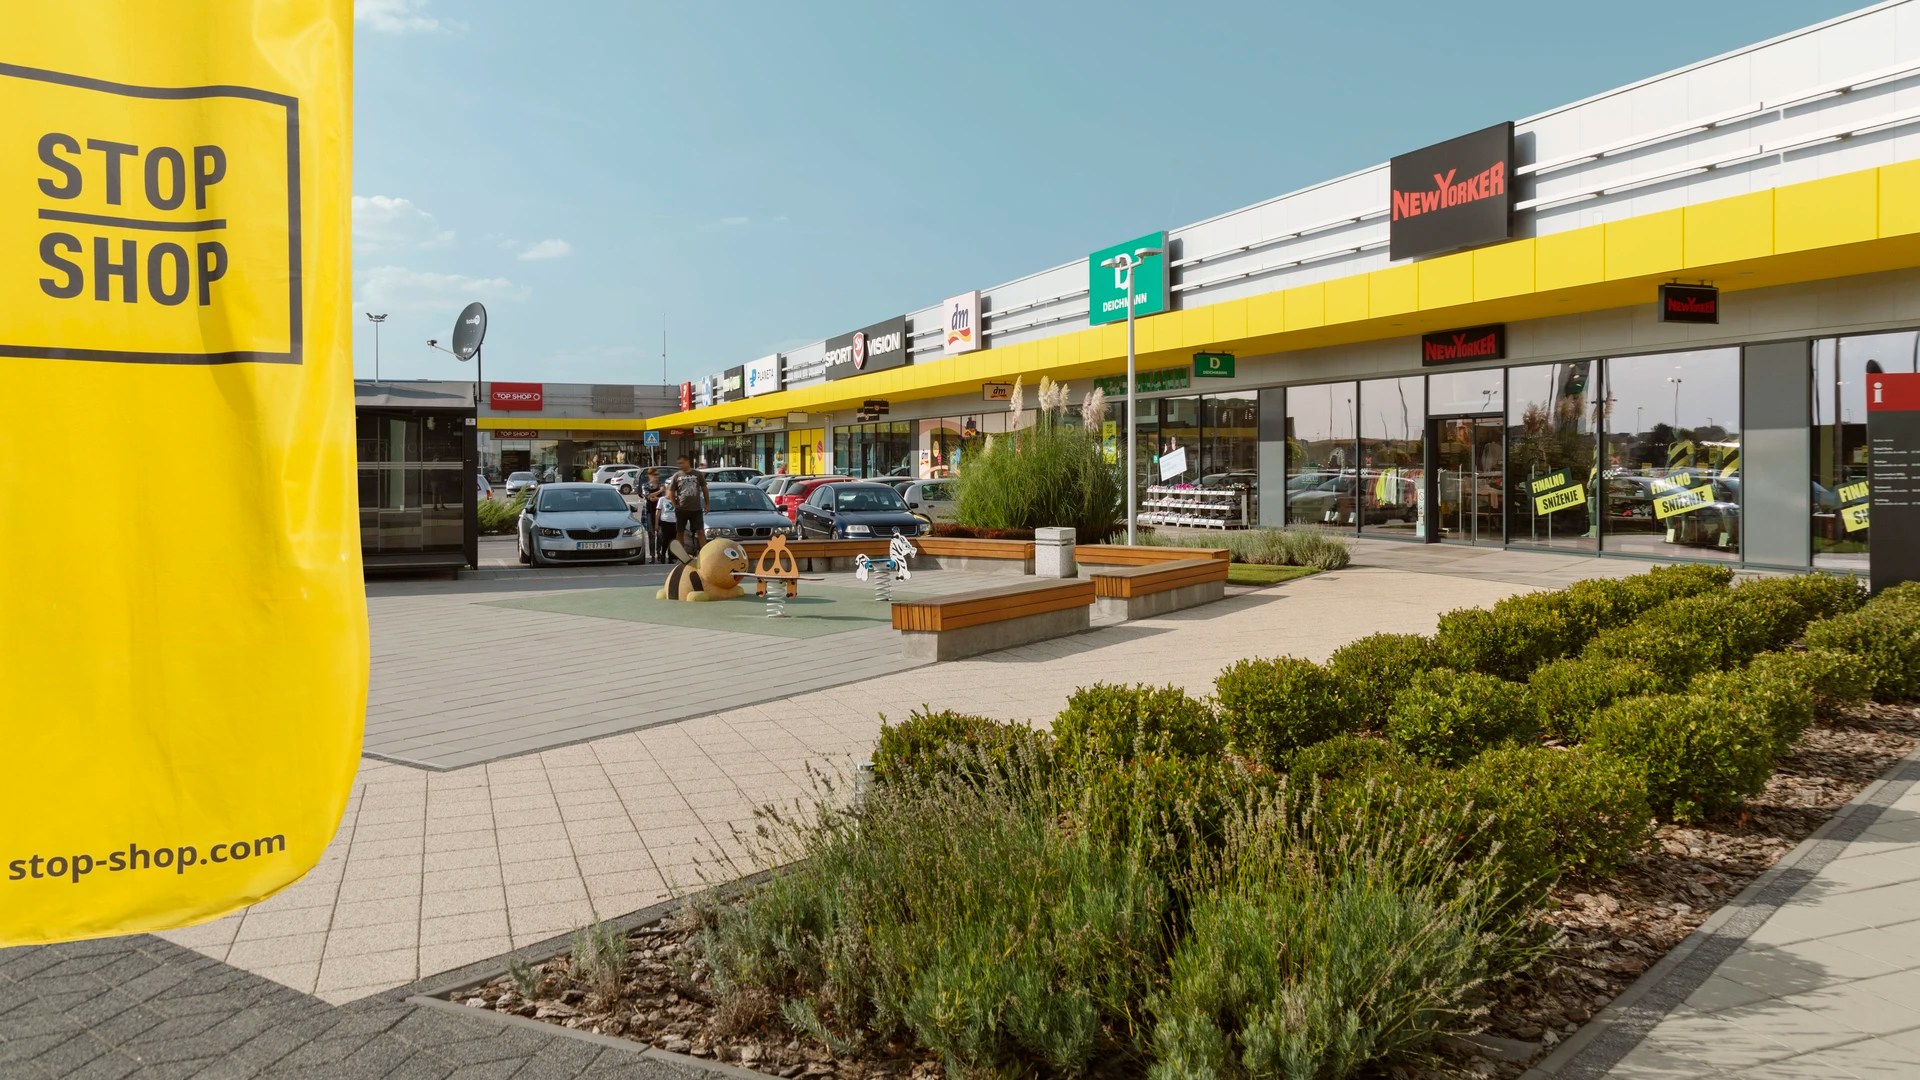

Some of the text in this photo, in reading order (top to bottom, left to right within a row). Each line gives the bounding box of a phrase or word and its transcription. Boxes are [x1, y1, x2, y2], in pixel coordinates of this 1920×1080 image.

[37, 132, 227, 211] STOP
[39, 232, 228, 306] SHOP
[951, 303, 969, 330] dm
[825, 331, 902, 368] SPORT VISION
[1210, 357, 1221, 369] D
[993, 386, 1006, 395] dm
[1532, 473, 1566, 494] FINALNO
[1650, 472, 1691, 495] FINALNO
[1838, 481, 1869, 503] FINA
[1542, 490, 1579, 510] SNIŽENJE
[1662, 491, 1706, 513] SNIŽENJE
[9, 834, 285, 883] stop-shop.com
